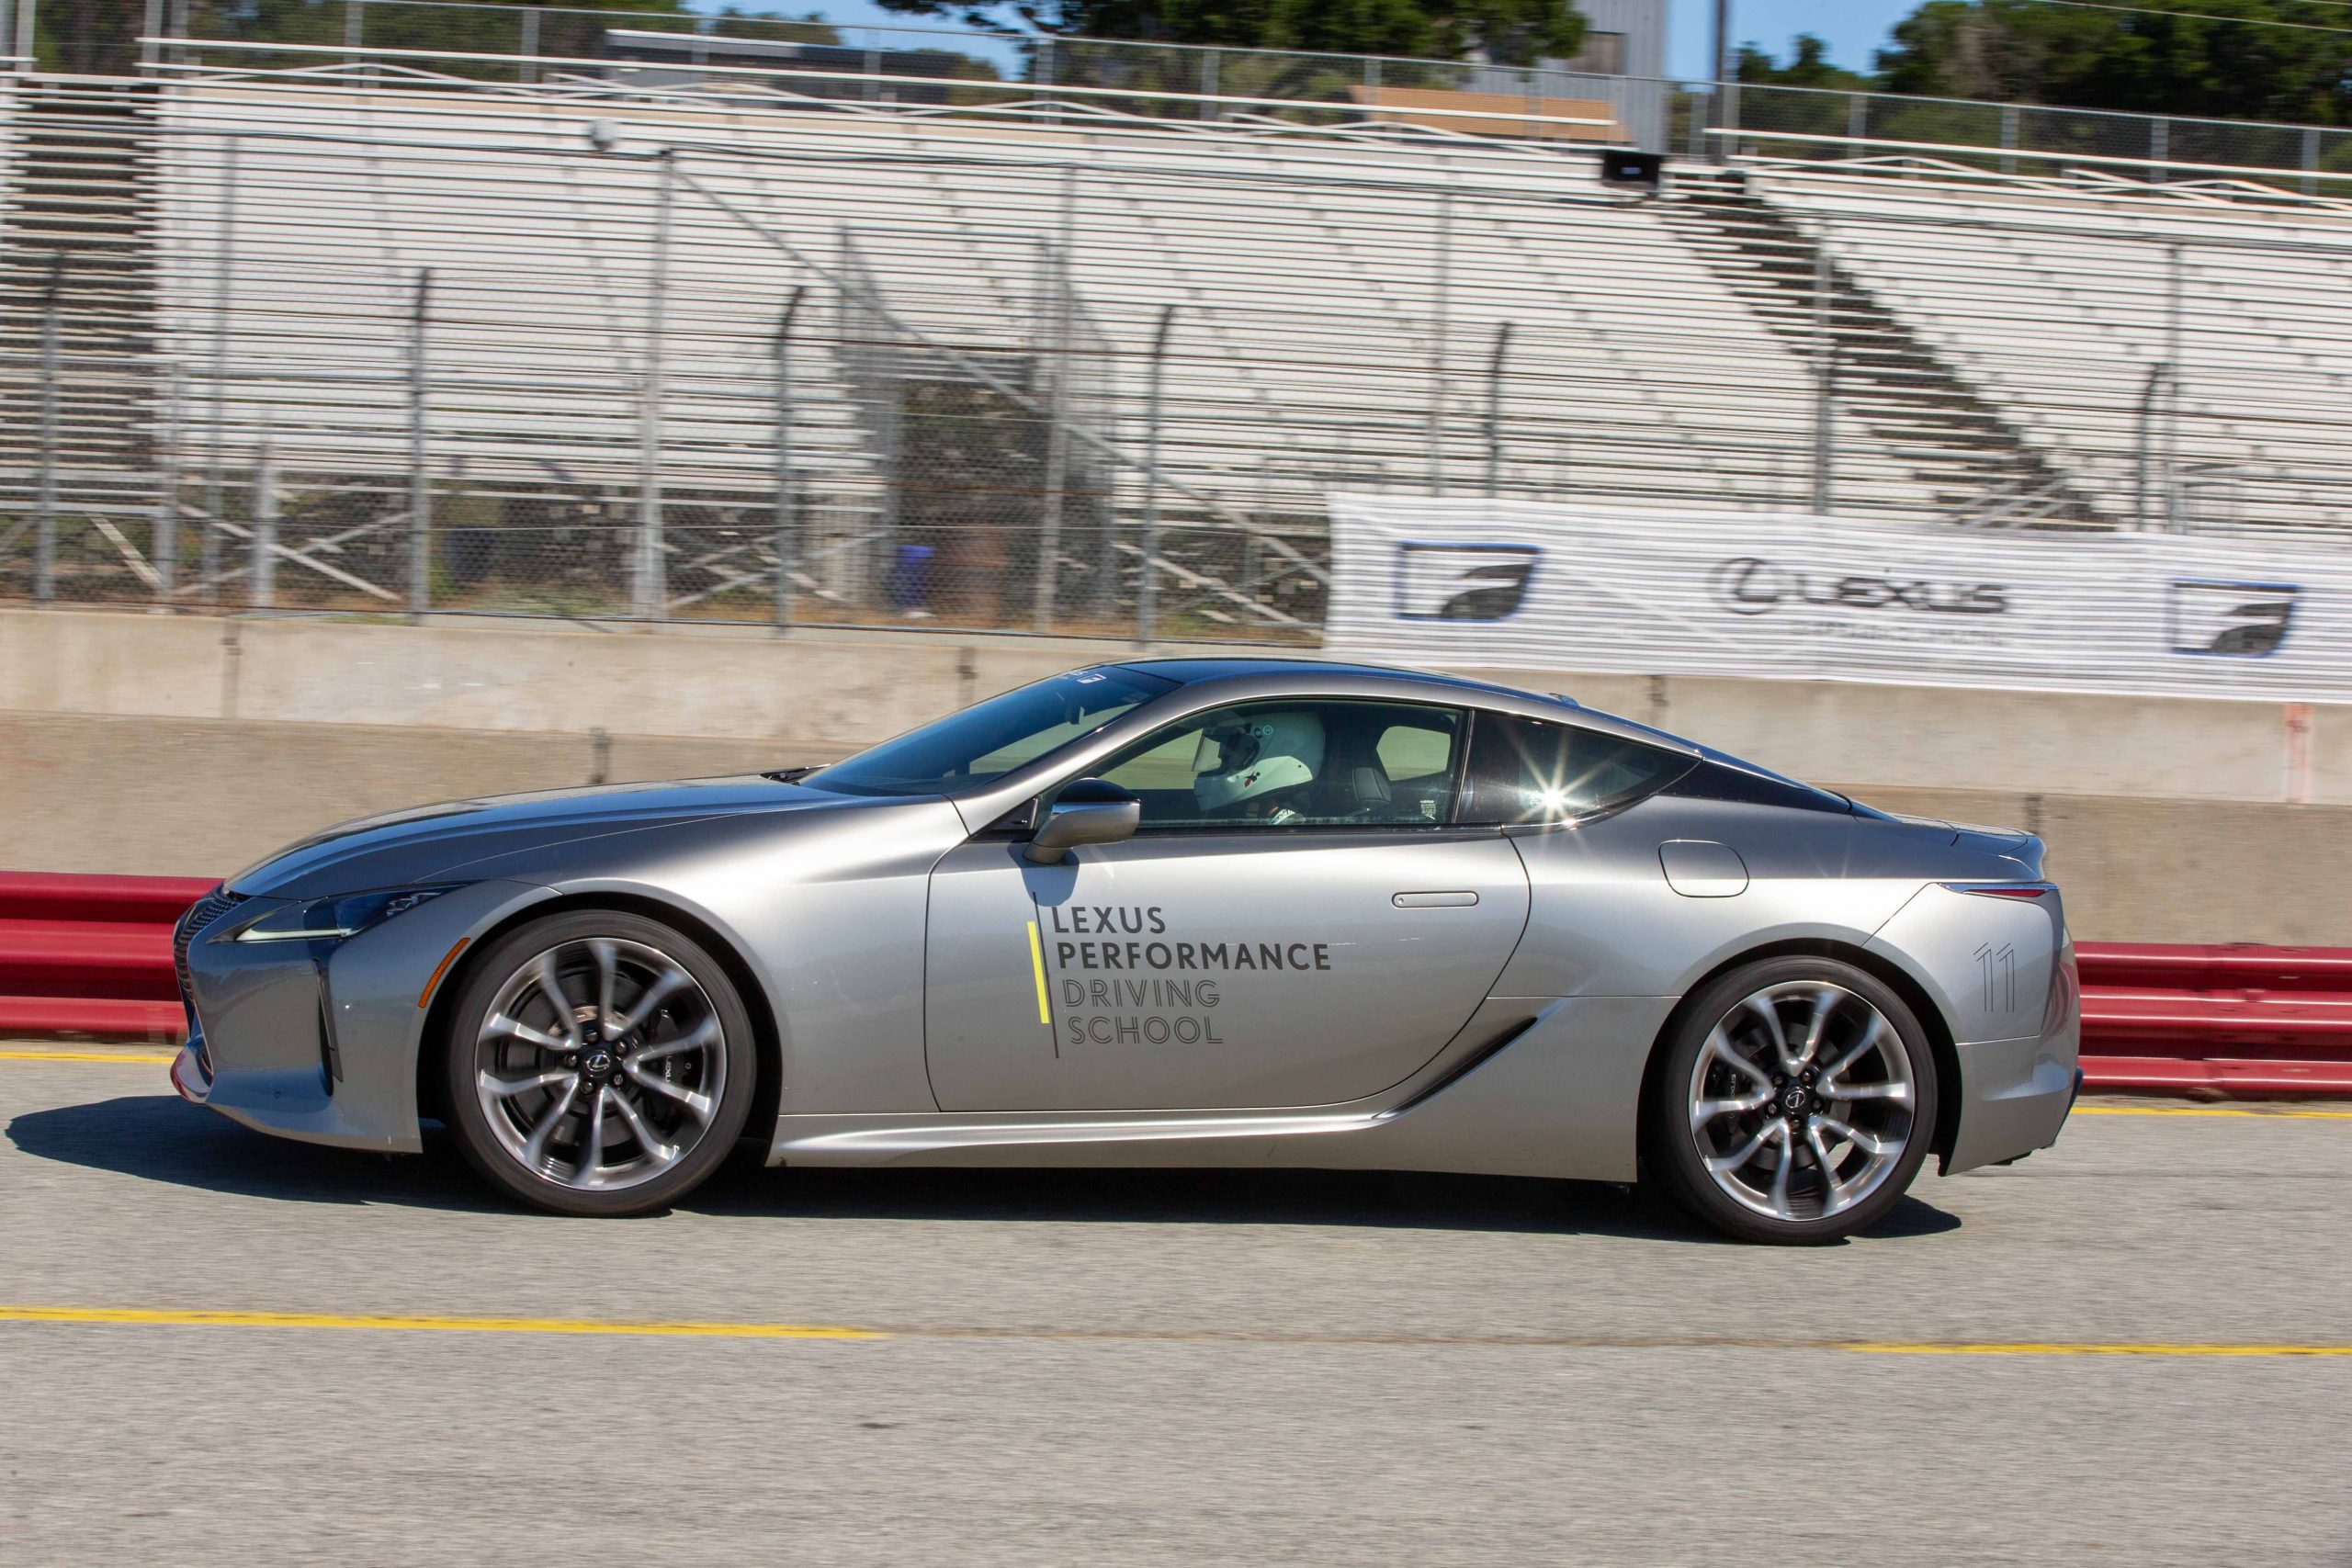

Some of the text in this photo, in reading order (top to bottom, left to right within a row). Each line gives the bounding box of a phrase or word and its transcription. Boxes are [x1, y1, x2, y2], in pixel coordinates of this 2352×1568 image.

[1798, 573, 2007, 614] LEXUS
[1052, 907, 1166, 934] LEXUS
[1057, 942, 1331, 971] PERFORMANCE
[1973, 942, 2014, 1012] 11
[1062, 979, 1220, 1008] DRIVING
[1068, 1016, 1224, 1044] SCHOOL
